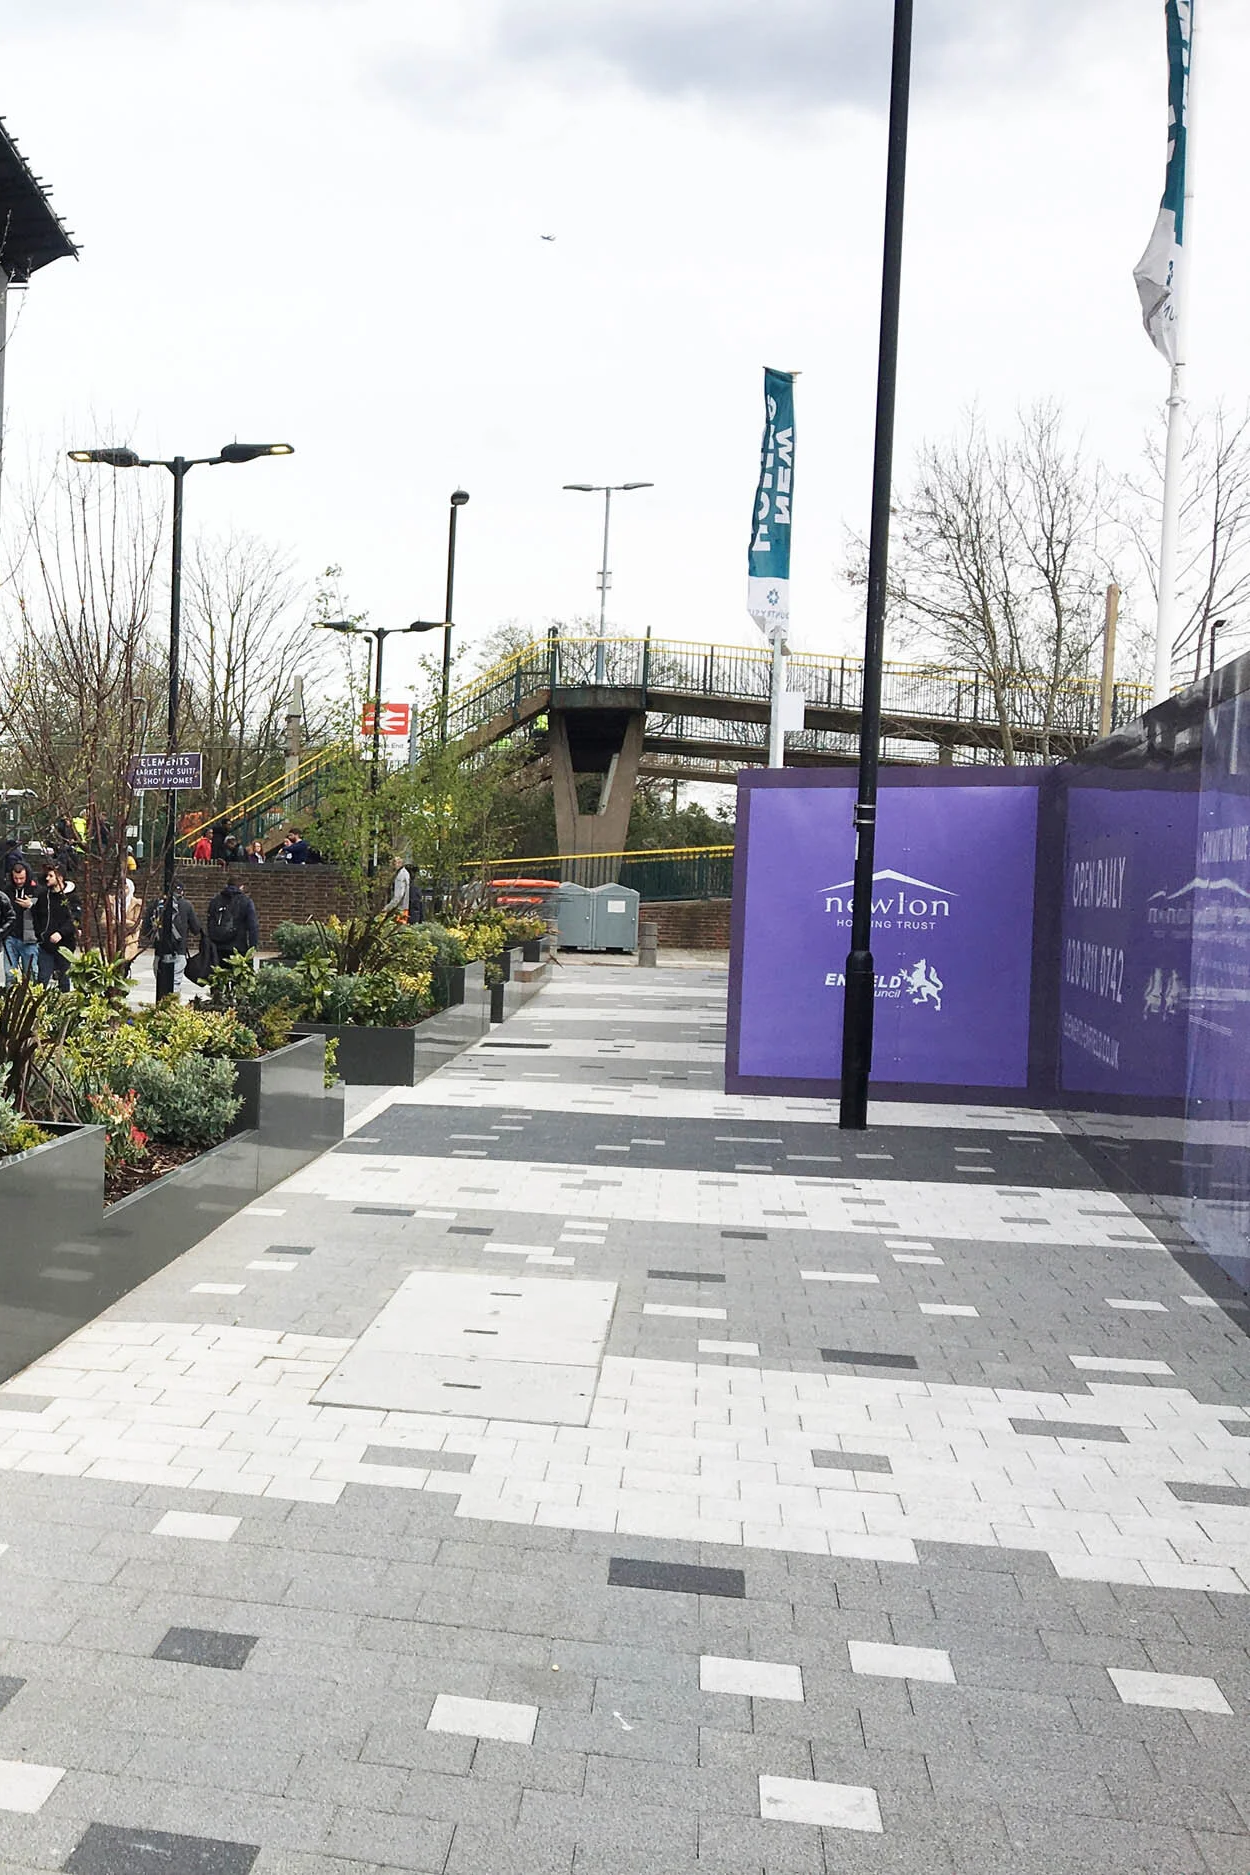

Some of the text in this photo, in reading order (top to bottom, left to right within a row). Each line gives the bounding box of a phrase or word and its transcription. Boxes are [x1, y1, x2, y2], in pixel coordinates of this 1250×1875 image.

[1073, 856, 1127, 908] OPEN DAILY
[837, 919, 937, 930] HOING TRUST
[825, 972, 902, 989] ENELD
[874, 989, 902, 999] uncil
